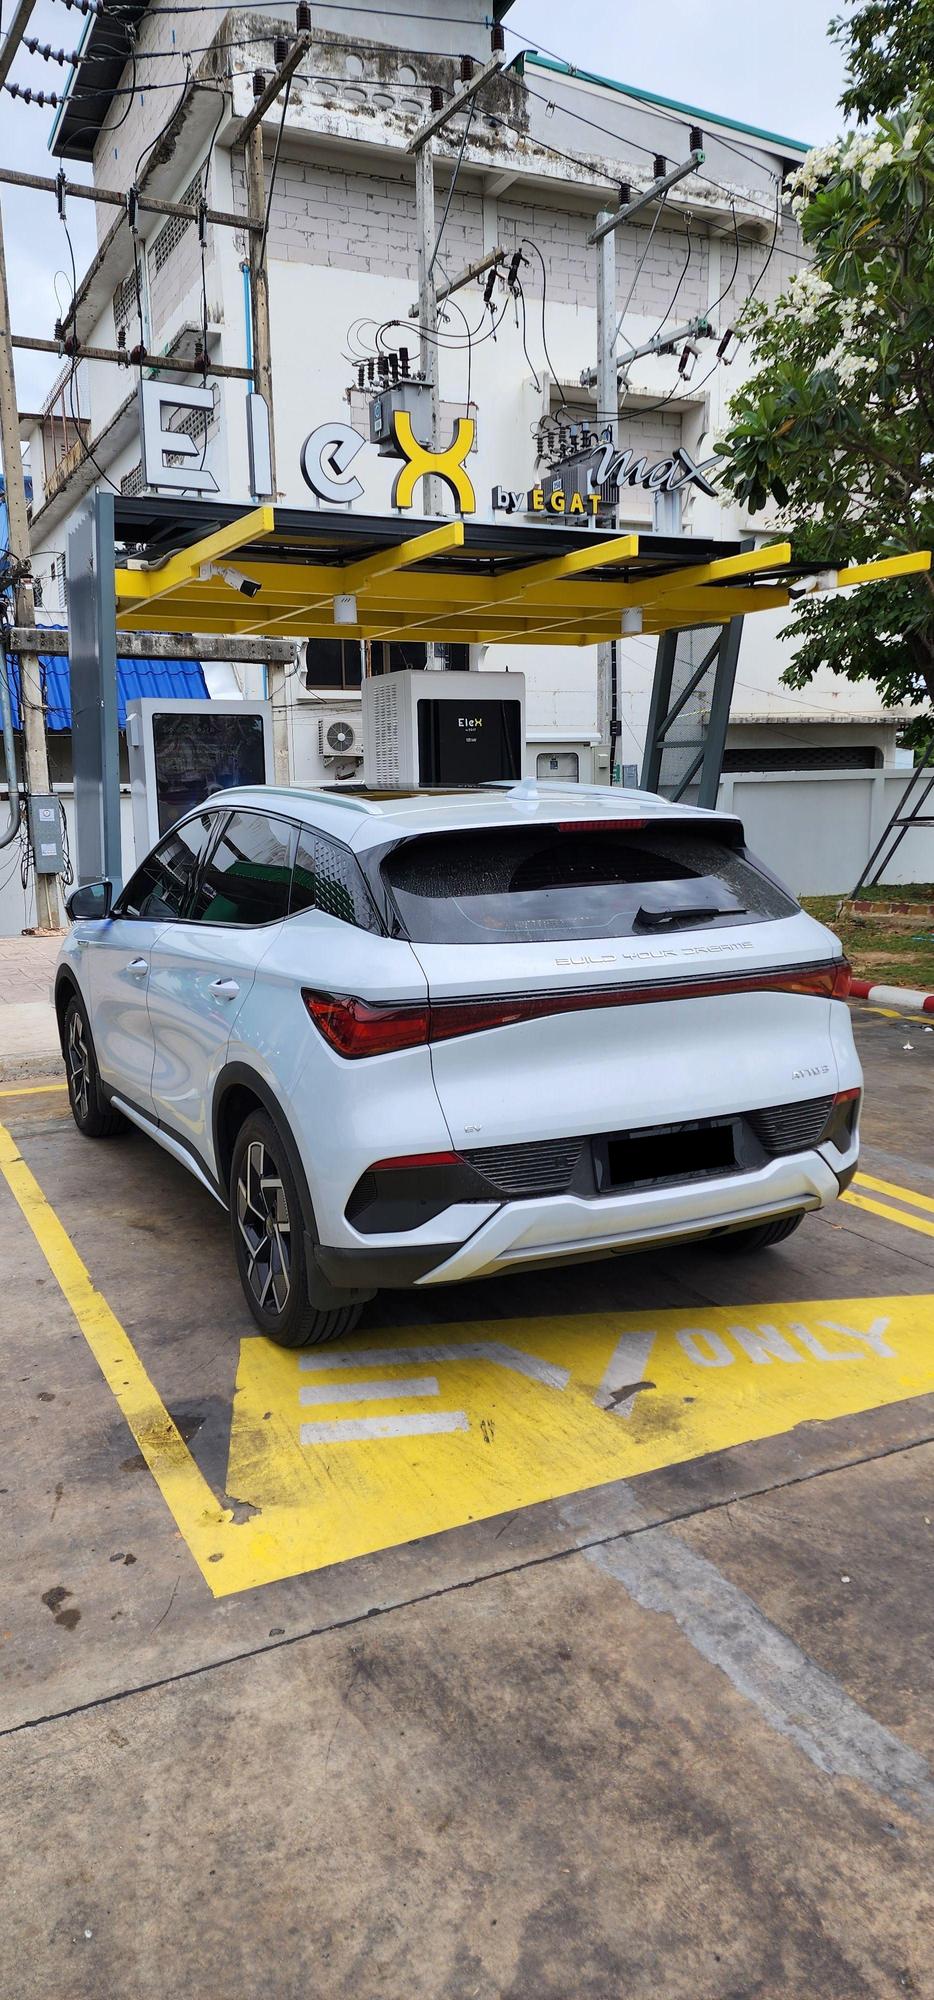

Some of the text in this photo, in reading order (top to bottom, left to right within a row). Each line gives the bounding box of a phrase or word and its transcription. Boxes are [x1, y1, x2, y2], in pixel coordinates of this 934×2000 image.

[492, 485, 524, 514] by
[530, 488, 602, 516] EGAT
[589, 442, 725, 497] max
[554, 941, 755, 967] BUILD YOUR DREAMS
[463, 1123, 482, 1134] EV
[299, 1317, 899, 1445] EV ONLY
